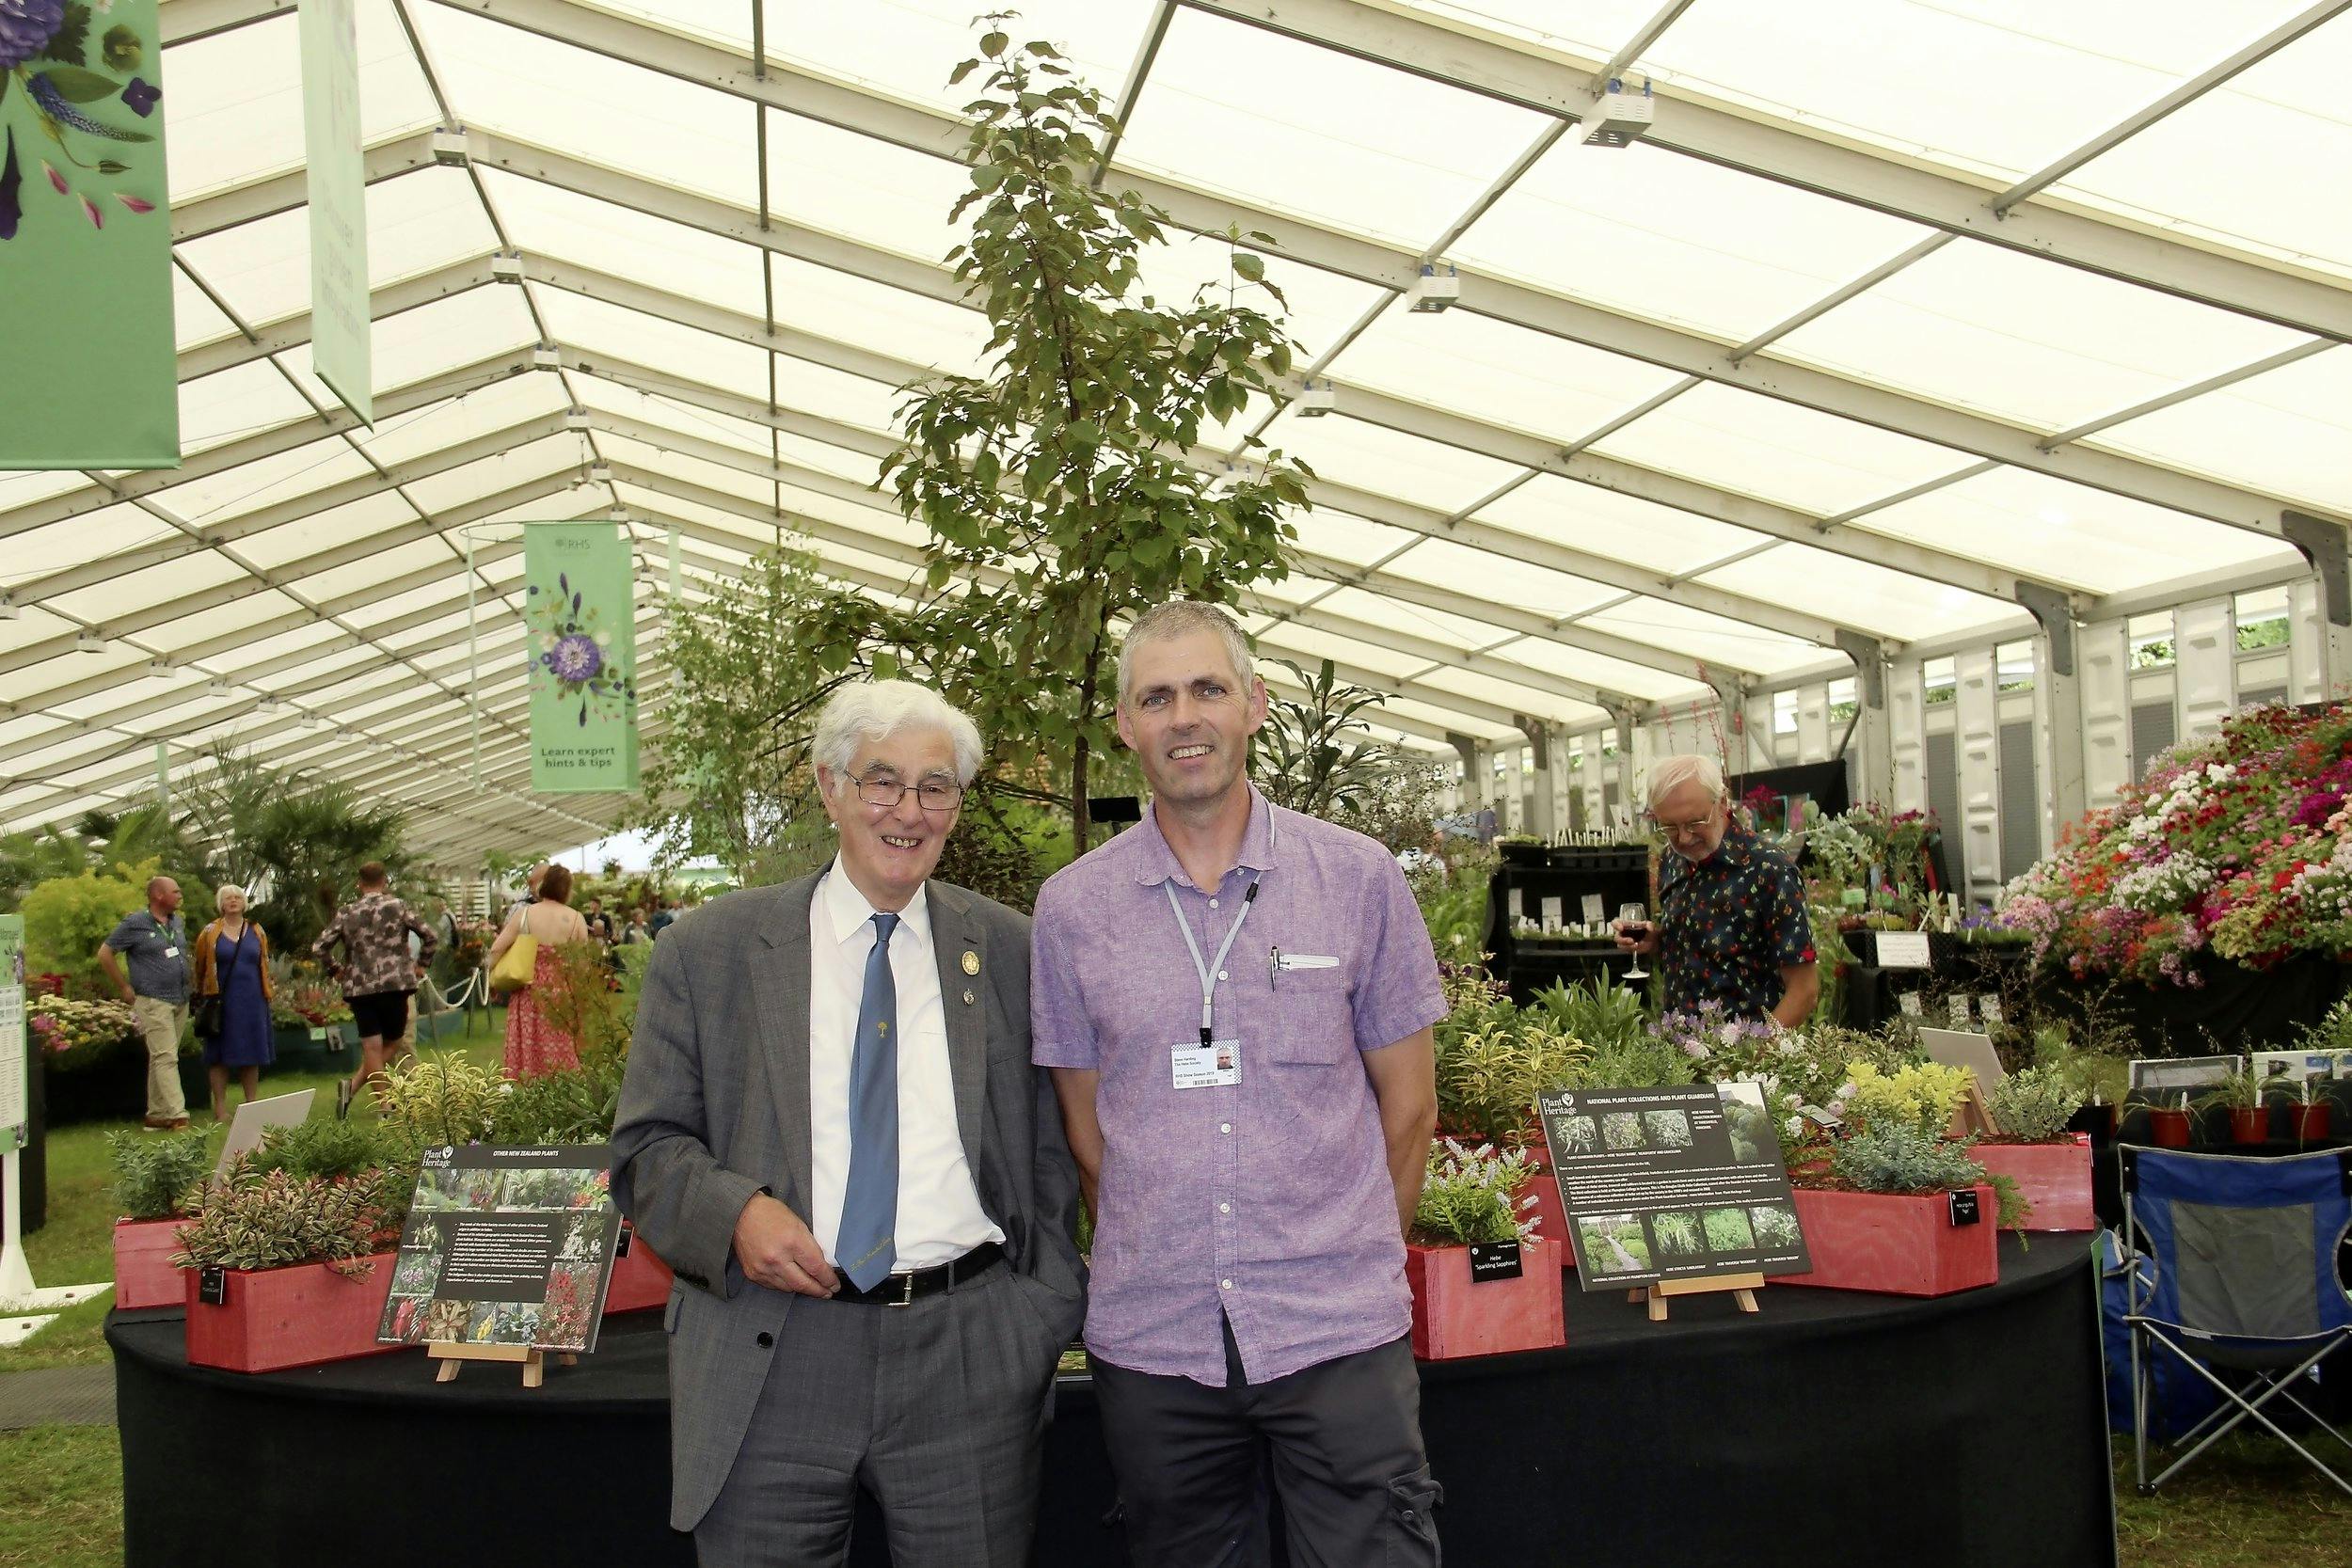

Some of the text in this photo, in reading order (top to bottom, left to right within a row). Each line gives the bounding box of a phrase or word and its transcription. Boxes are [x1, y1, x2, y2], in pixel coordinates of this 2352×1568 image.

[541, 747, 615, 757] Learn expert
[546, 758, 575, 768] hints
[591, 759, 612, 768] tips
[1541, 1098, 1562, 1106] Plant
[1544, 1106, 1577, 1117] Heritage
[423, 1149, 442, 1158] Plant
[421, 1158, 452, 1167] Heritage
